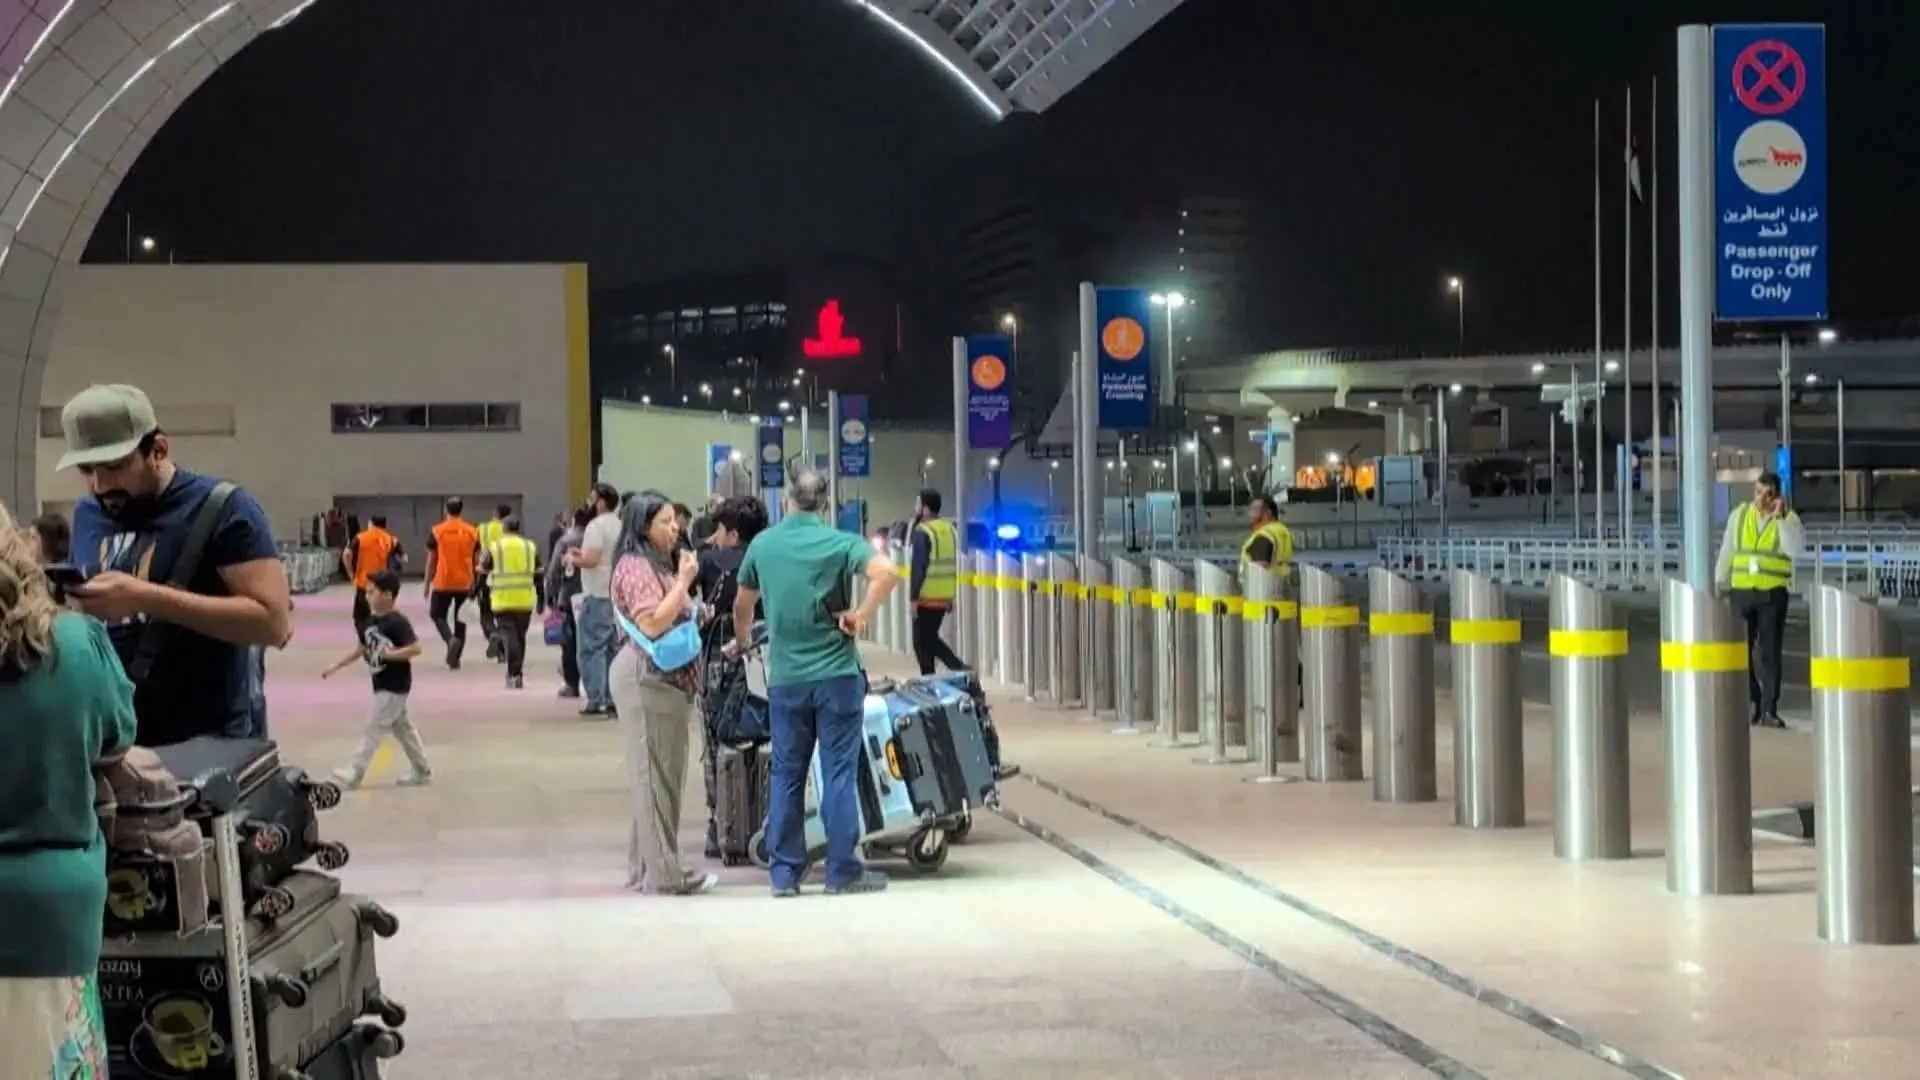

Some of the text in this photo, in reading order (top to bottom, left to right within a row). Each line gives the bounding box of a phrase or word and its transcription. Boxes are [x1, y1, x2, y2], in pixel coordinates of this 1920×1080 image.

[1723, 204, 1819, 224] نزول المسافرين
[1757, 222, 1788, 238] فقط
[1724, 243, 1819, 262] Passenger
[1731, 263, 1775, 282] Drop
[1785, 262, 1812, 279] Off
[1751, 283, 1792, 303] Only
[100, 959, 142, 977] ozay
